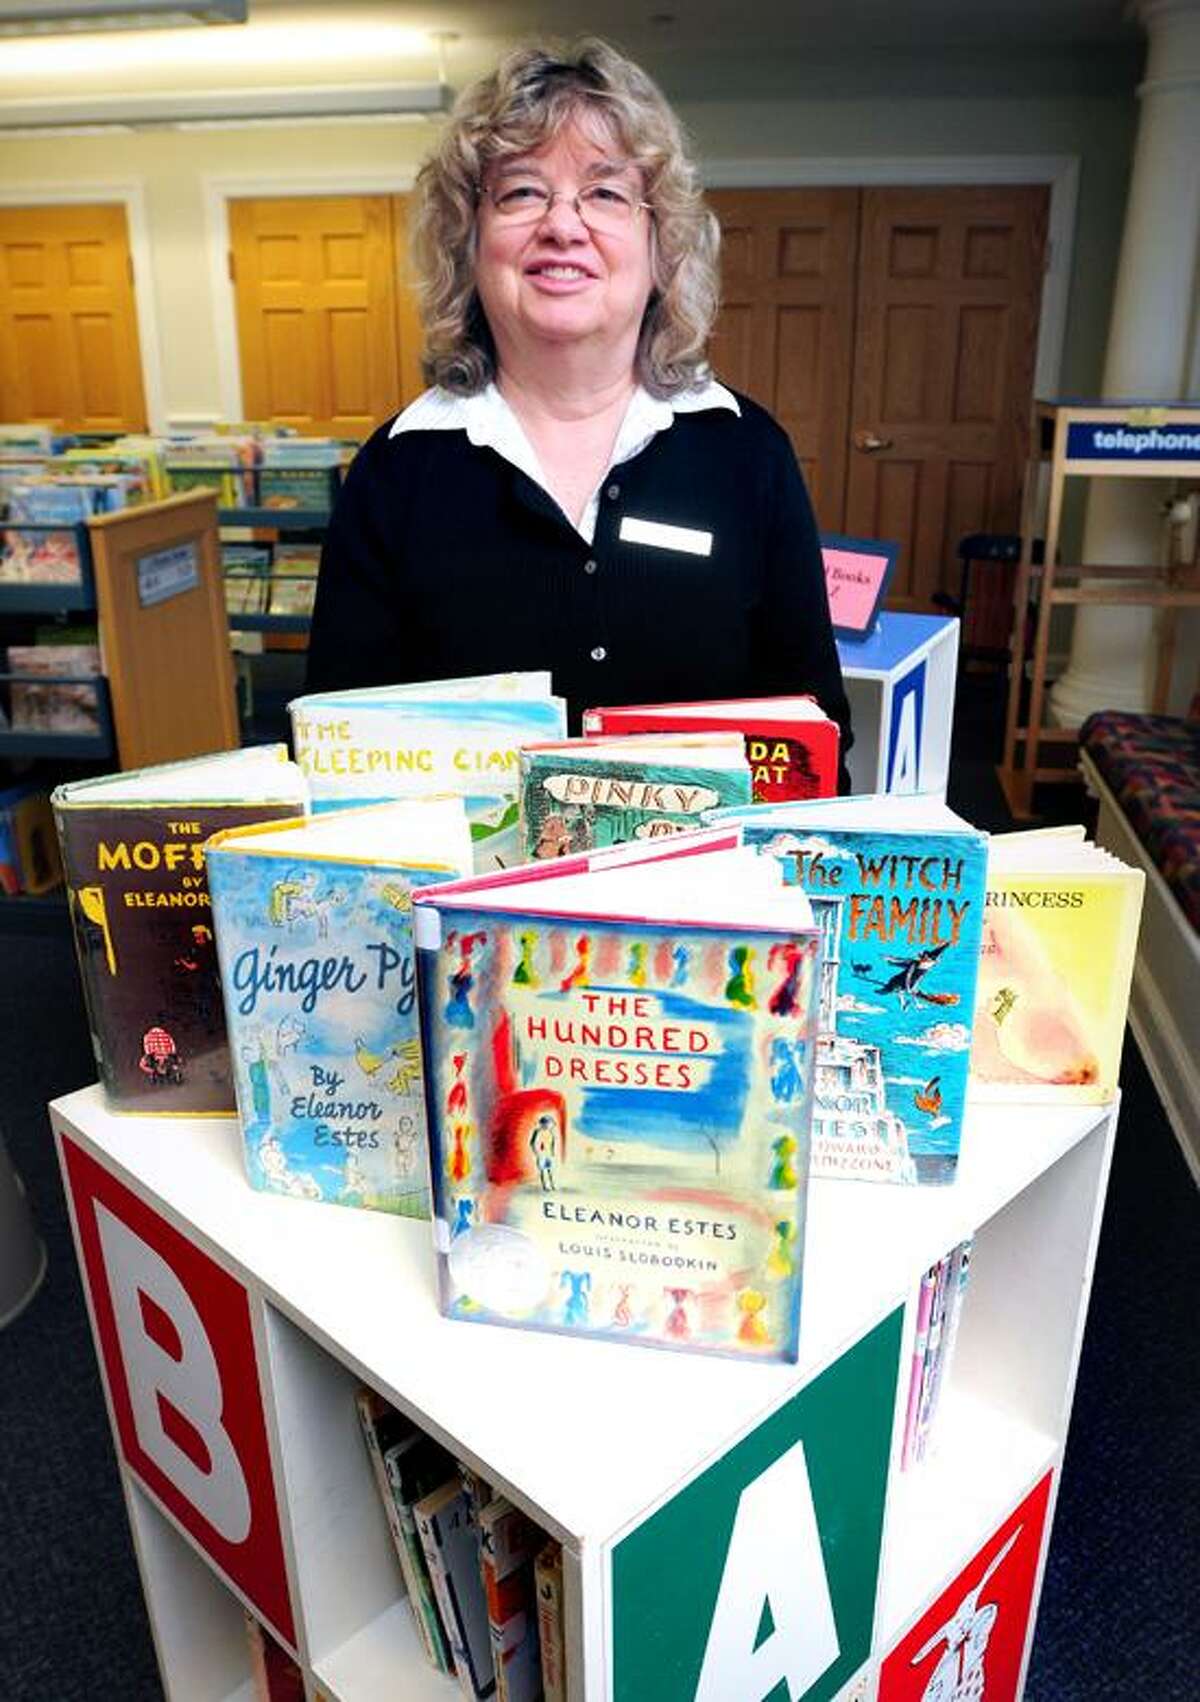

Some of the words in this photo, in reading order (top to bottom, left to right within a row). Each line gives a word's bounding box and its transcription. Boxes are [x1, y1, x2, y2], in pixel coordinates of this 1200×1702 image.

[1094, 429, 1200, 453] telephone
[297, 722, 350, 740] THE
[889, 691, 918, 793] A
[299, 748, 433, 776] SLEEPING
[750, 742, 790, 762] DA
[565, 778, 698, 812] PINKY
[167, 822, 201, 834] THE
[182, 876, 202, 888] BY
[788, 850, 844, 887] The
[856, 854, 964, 894] WITCH
[124, 892, 211, 907] ELEANOR
[985, 891, 1084, 908] RINCESS
[847, 894, 971, 945] FAMILY
[233, 944, 367, 1016] Ginger
[367, 942, 416, 1015] Py
[582, 994, 648, 1017] THE
[527, 1017, 710, 1052] HUNDRED
[310, 1064, 345, 1095] By
[544, 1056, 692, 1089] DRESSES
[290, 1096, 382, 1121] Eleanor
[314, 1126, 379, 1148] Estes
[543, 1202, 658, 1231] ELEANOR
[669, 1218, 737, 1241] ESTES
[559, 1241, 612, 1259] LOUIS
[94, 1197, 251, 1544] B
[694, 1439, 841, 1702] A
